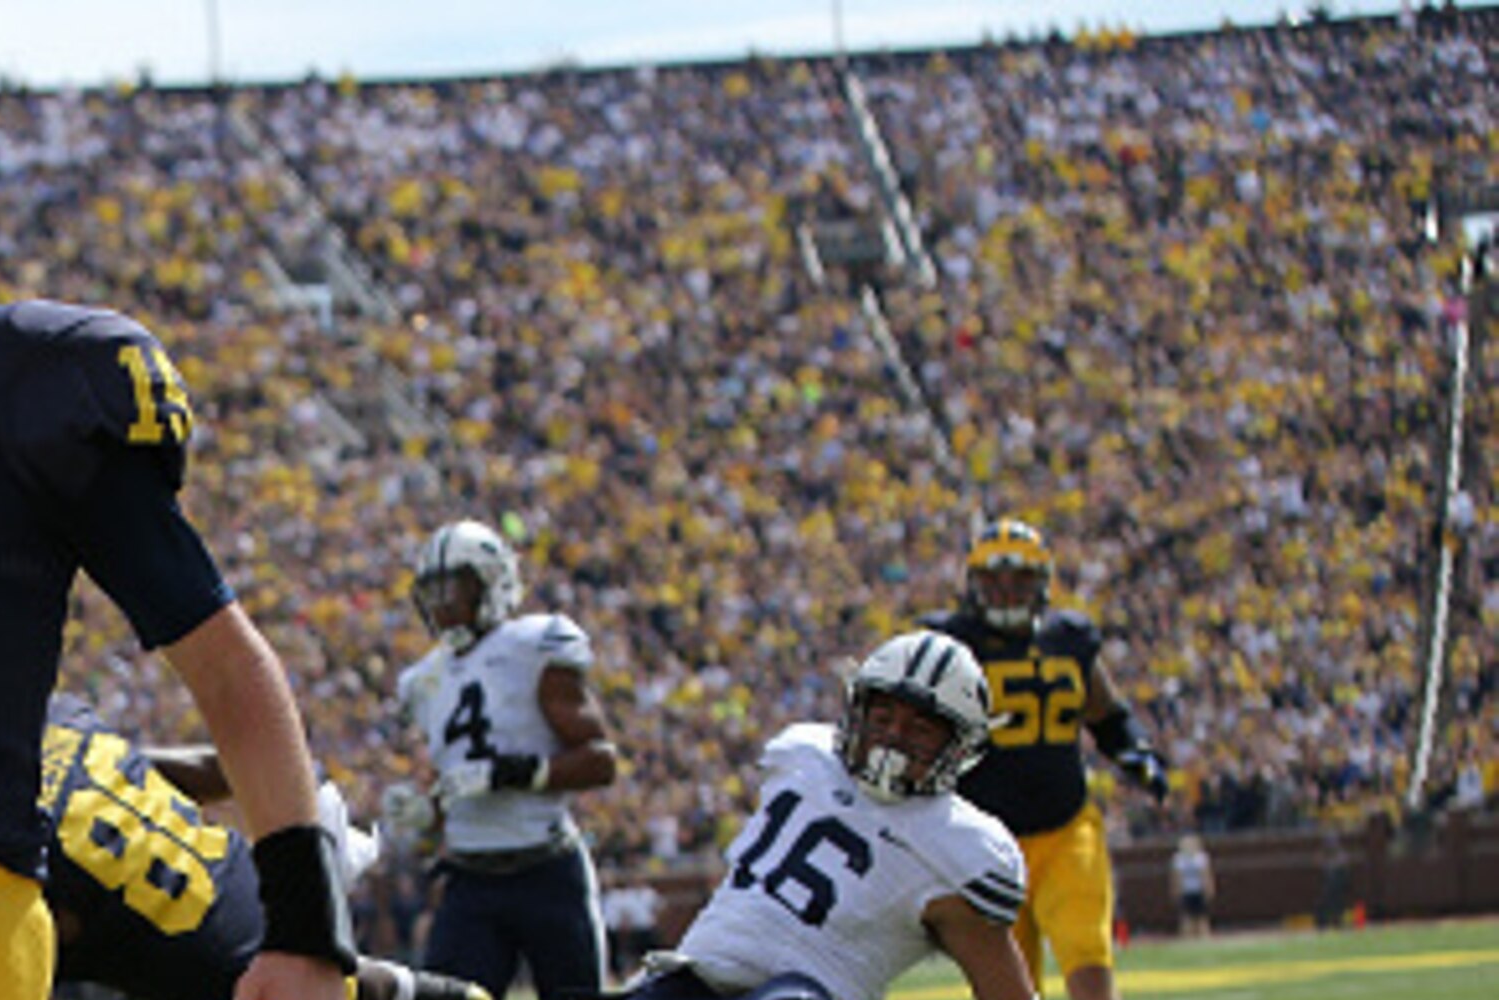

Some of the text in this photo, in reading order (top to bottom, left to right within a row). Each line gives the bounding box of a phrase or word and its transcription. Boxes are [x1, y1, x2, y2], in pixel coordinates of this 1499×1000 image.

[444, 681, 499, 761] 4
[985, 655, 1087, 746] 52
[732, 788, 874, 929] 16
